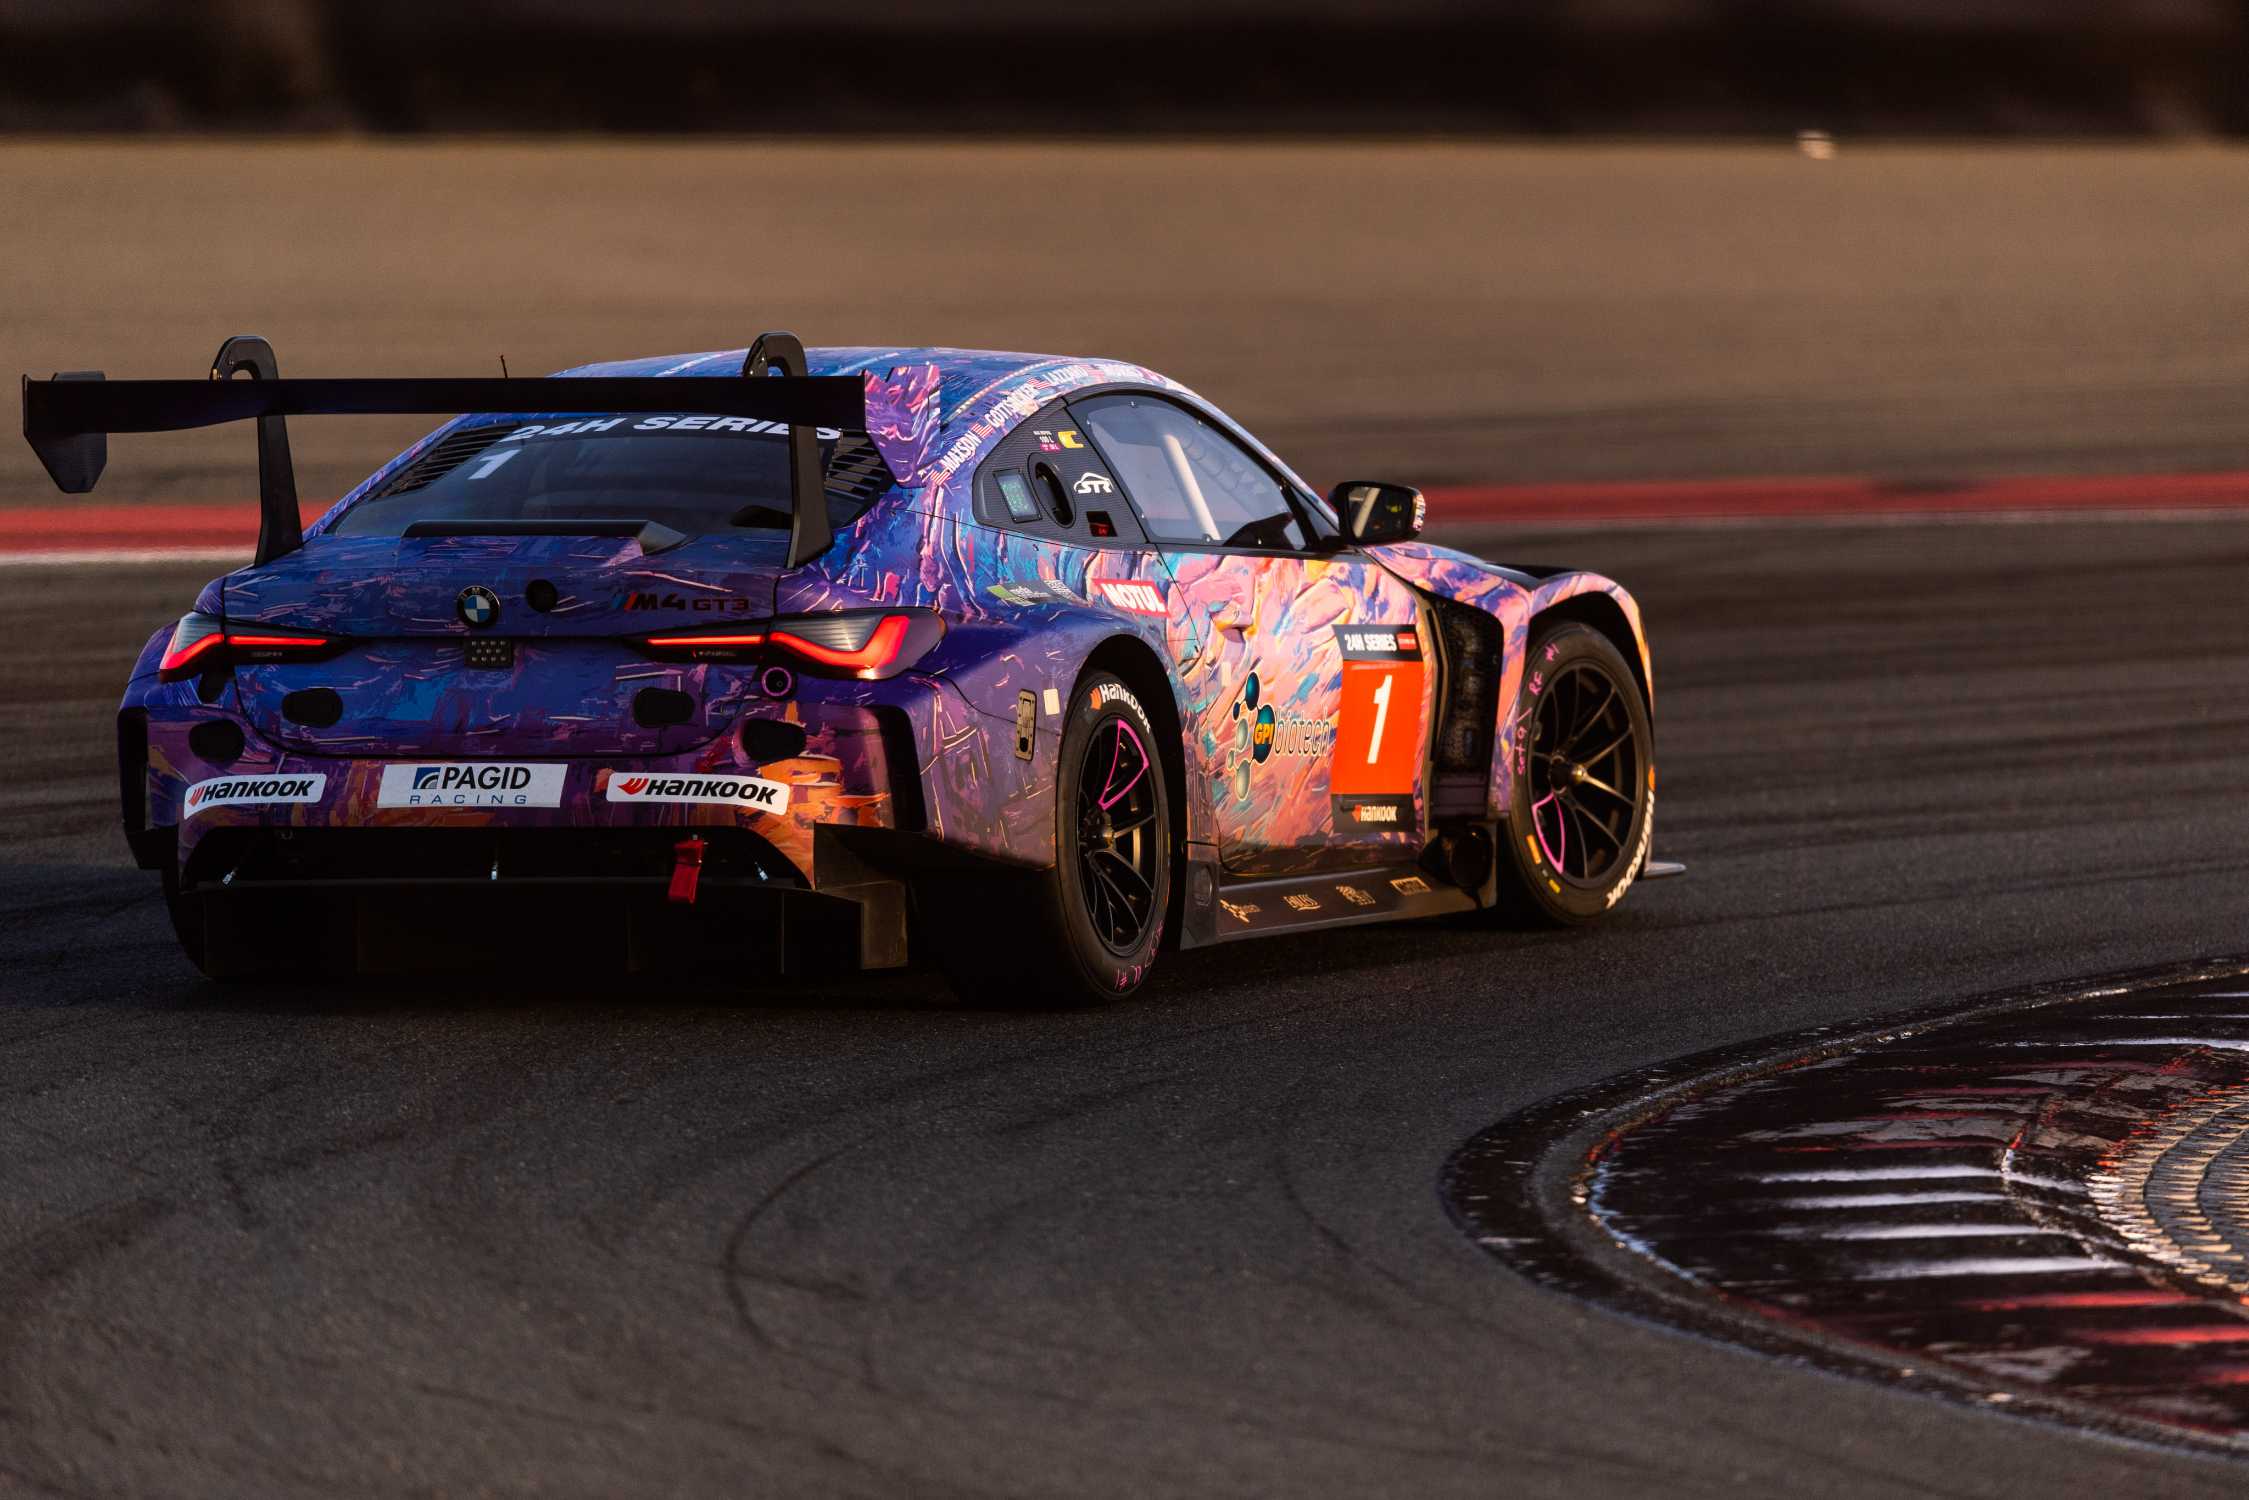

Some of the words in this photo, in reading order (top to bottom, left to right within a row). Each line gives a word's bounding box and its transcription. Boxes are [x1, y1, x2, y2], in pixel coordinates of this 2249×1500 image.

[498, 417, 628, 443] 24H
[467, 449, 522, 480] 1
[940, 430, 982, 474] MAXSON
[692, 597, 750, 612] GT3
[1101, 583, 1166, 613] MOTUL
[1344, 633, 1366, 651] 24H
[1364, 633, 1397, 652] SERIES
[1254, 723, 1274, 745] GPI
[1274, 708, 1330, 755] biotech
[1366, 674, 1393, 764] 1
[441, 766, 532, 790] PAGID
[409, 793, 527, 805] RACING
